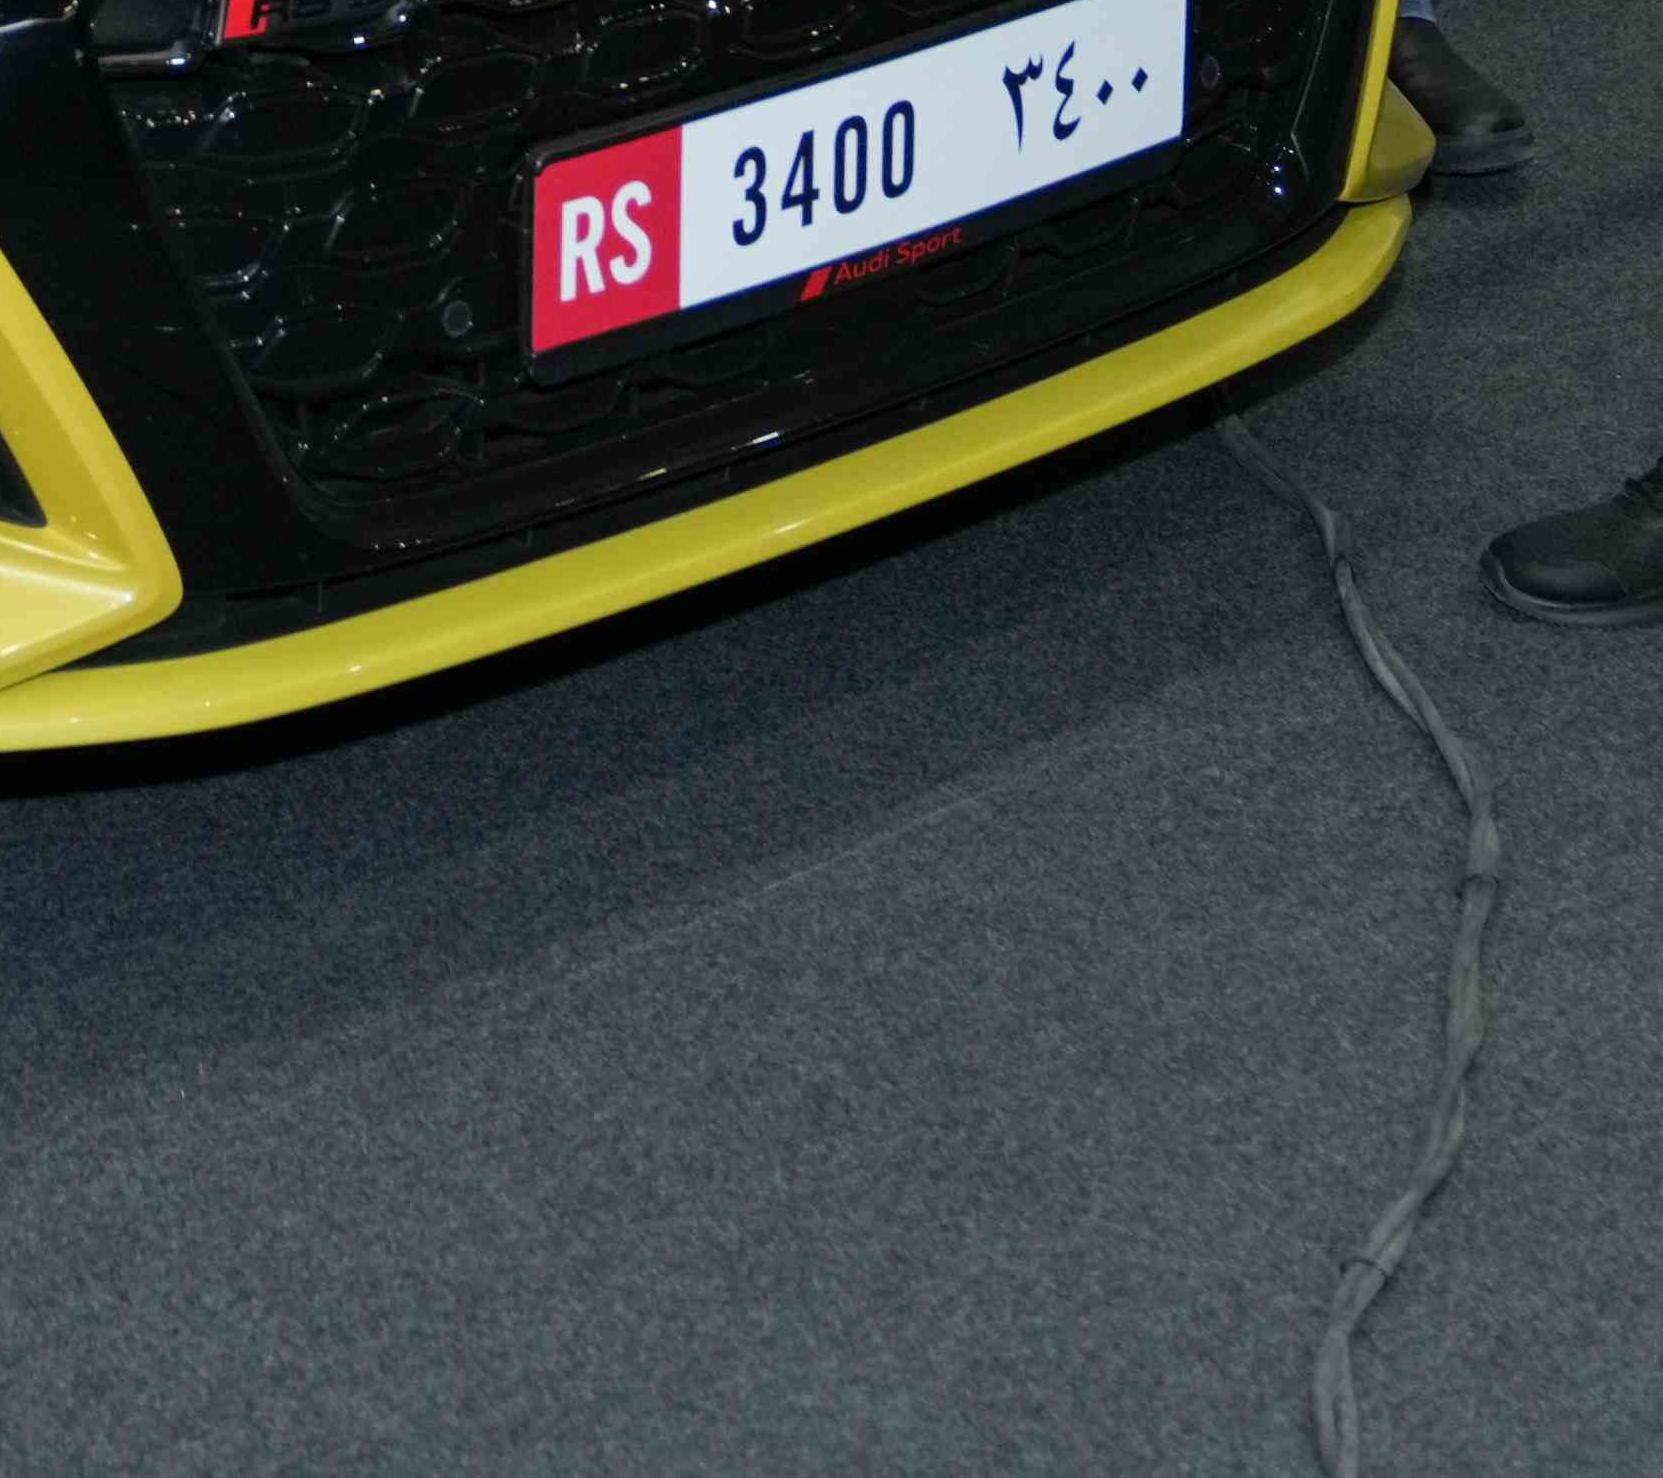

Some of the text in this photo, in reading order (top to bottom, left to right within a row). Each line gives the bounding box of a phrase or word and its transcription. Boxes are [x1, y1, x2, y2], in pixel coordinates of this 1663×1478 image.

[1001, 39, 1149, 154] ٣٤٠٠
[731, 99, 917, 247] 3400
[559, 179, 653, 303] RS
[834, 226, 963, 285] Audi Sport
